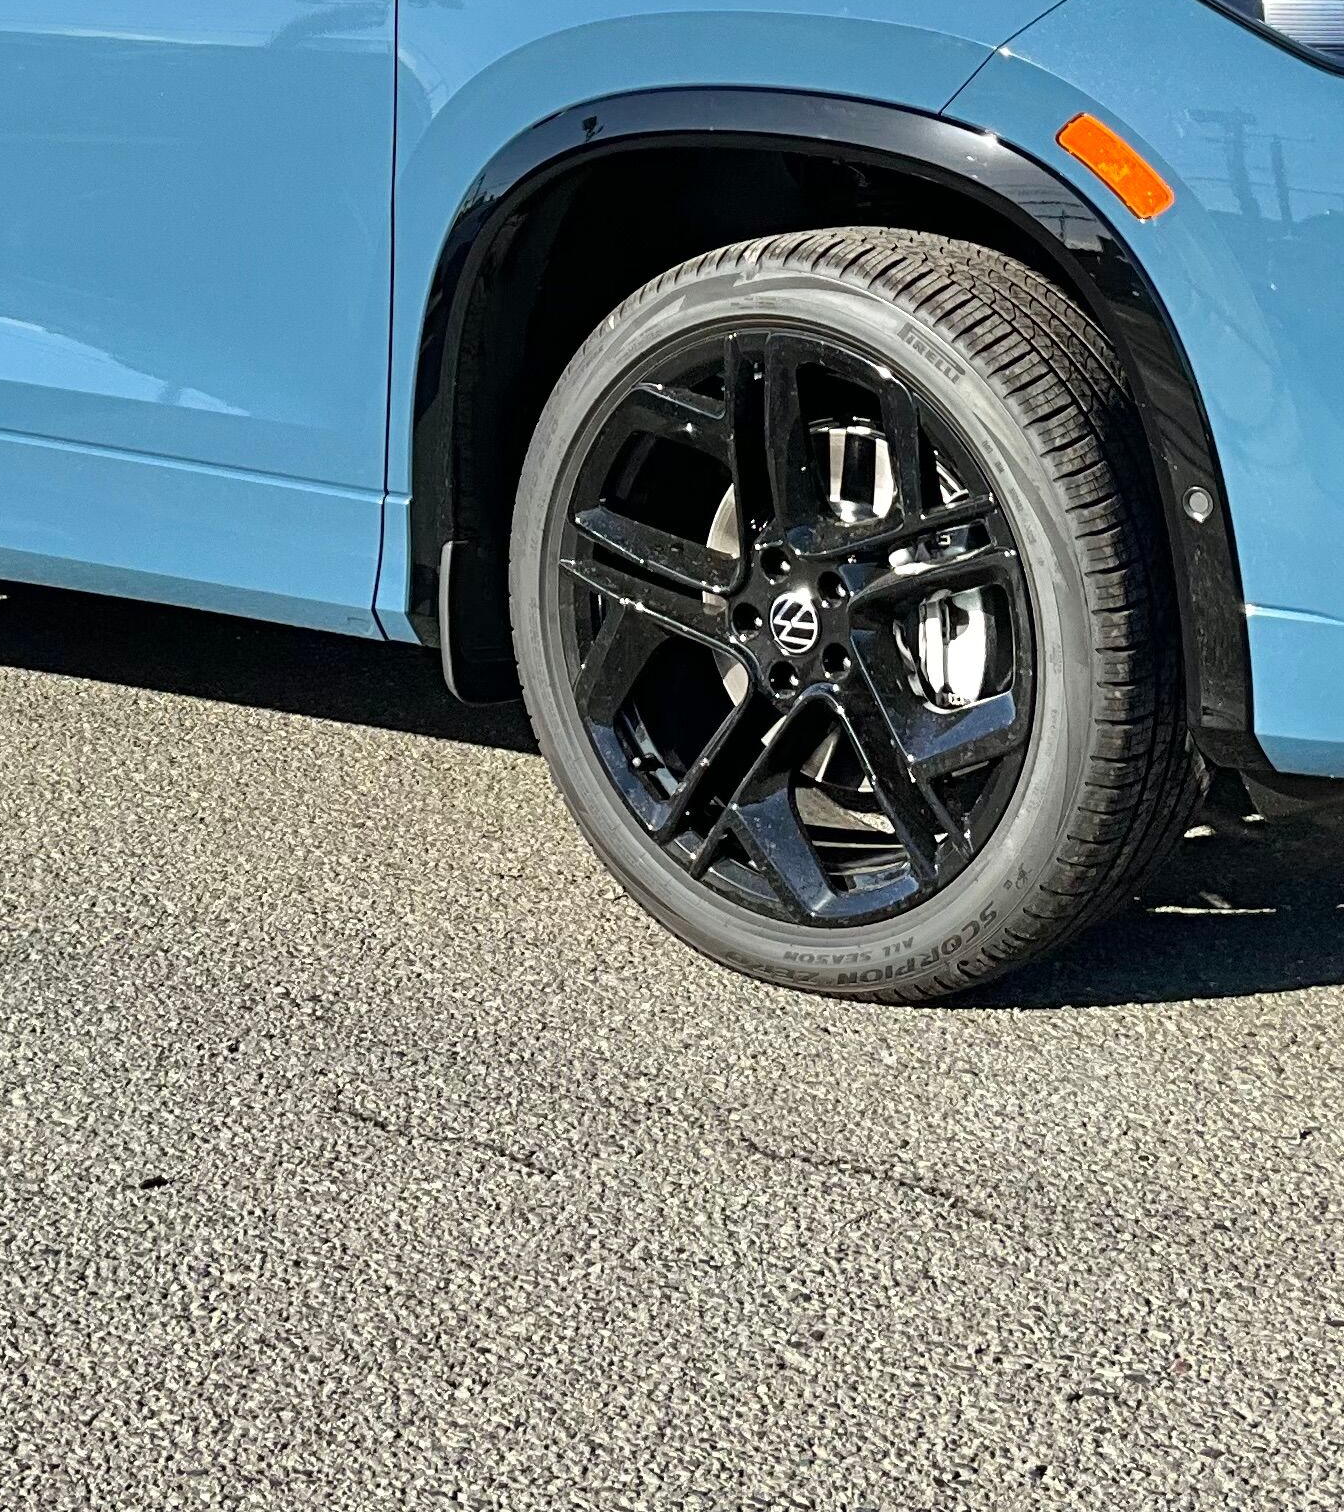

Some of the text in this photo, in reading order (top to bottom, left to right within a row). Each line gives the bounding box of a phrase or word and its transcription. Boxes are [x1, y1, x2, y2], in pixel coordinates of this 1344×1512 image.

[897, 322, 966, 384] PIRELLI
[783, 936, 914, 965] ALL SEASON
[837, 901, 997, 986] SCORPION
